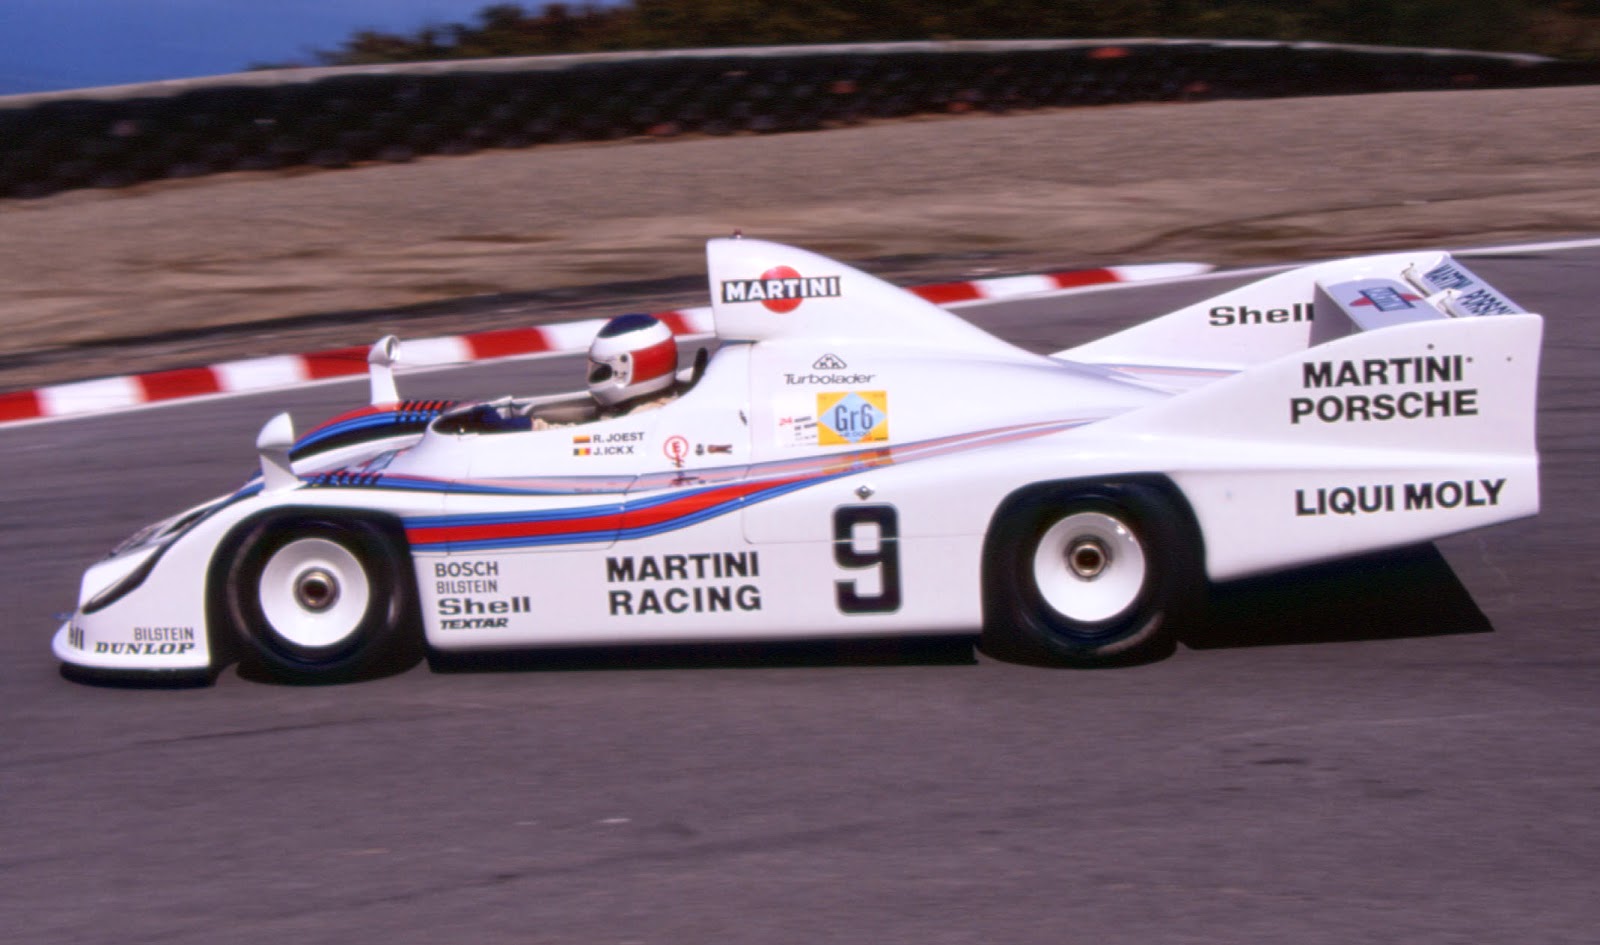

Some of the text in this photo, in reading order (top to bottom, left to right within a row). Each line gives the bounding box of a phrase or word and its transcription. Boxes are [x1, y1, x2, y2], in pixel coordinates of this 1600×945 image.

[726, 277, 837, 301] MARTINI
[1209, 303, 1314, 326] Shell
[784, 373, 876, 385] Turbolader
[1303, 355, 1463, 388] MARTINI
[834, 402, 873, 432] Gr6
[1290, 389, 1478, 424] PORSCHE
[606, 432, 645, 442] JOEST
[1295, 478, 1506, 516] LIQUI MOLY
[434, 560, 499, 577] BOSCH
[606, 551, 759, 582] MARTINI
[832, 503, 902, 615] 9
[436, 579, 498, 594] BILSTEIN
[438, 596, 531, 615] Shell
[608, 585, 762, 616] RACING
[134, 627, 194, 641] BILSTEIN
[440, 617, 509, 630] TEXTAR
[95, 641, 195, 655] DUNLOP
